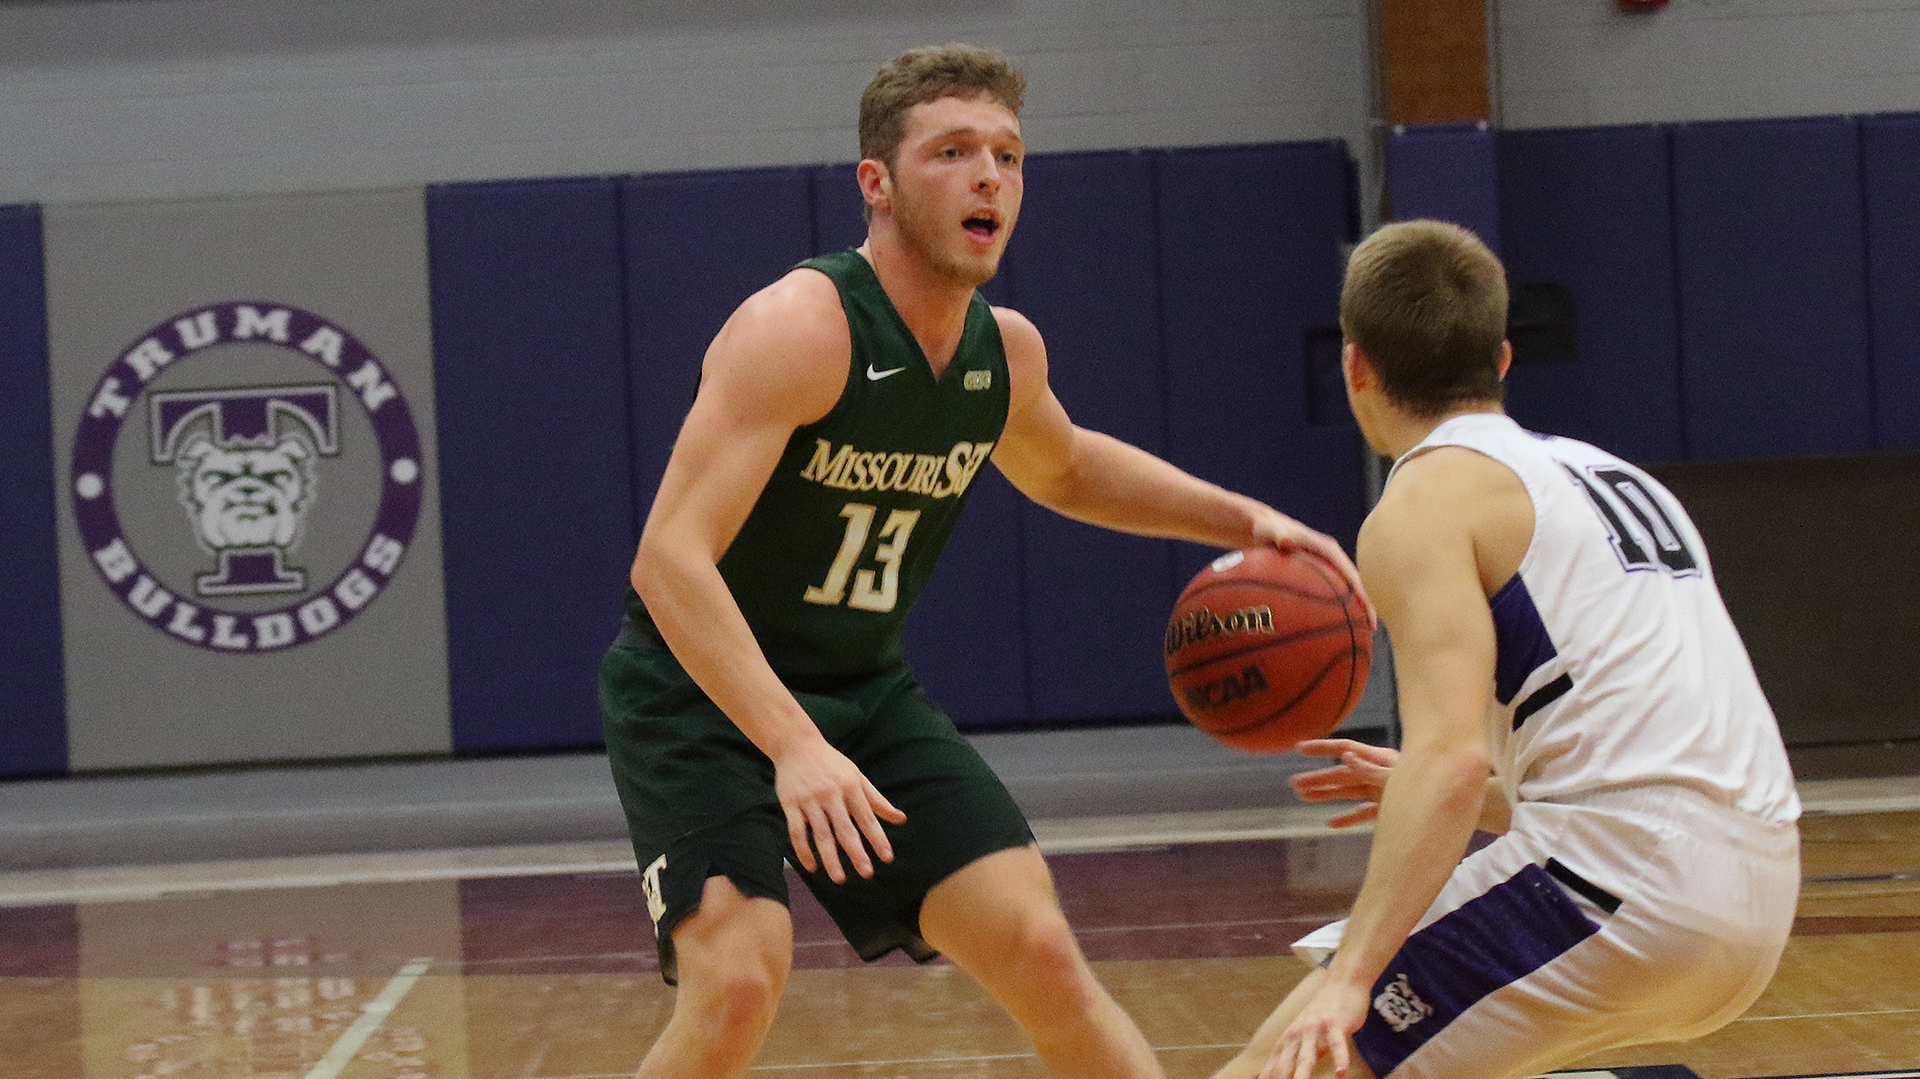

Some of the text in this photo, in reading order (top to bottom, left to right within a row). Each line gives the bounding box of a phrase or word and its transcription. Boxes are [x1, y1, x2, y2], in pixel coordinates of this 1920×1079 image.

[91, 305, 397, 418] TRUMAN
[803, 502, 921, 613] 13
[1554, 460, 1702, 579] 10
[94, 533, 403, 649] BULLDOGS
[1164, 604, 1275, 656] Wilson
[1183, 665, 1270, 708] NCAA
